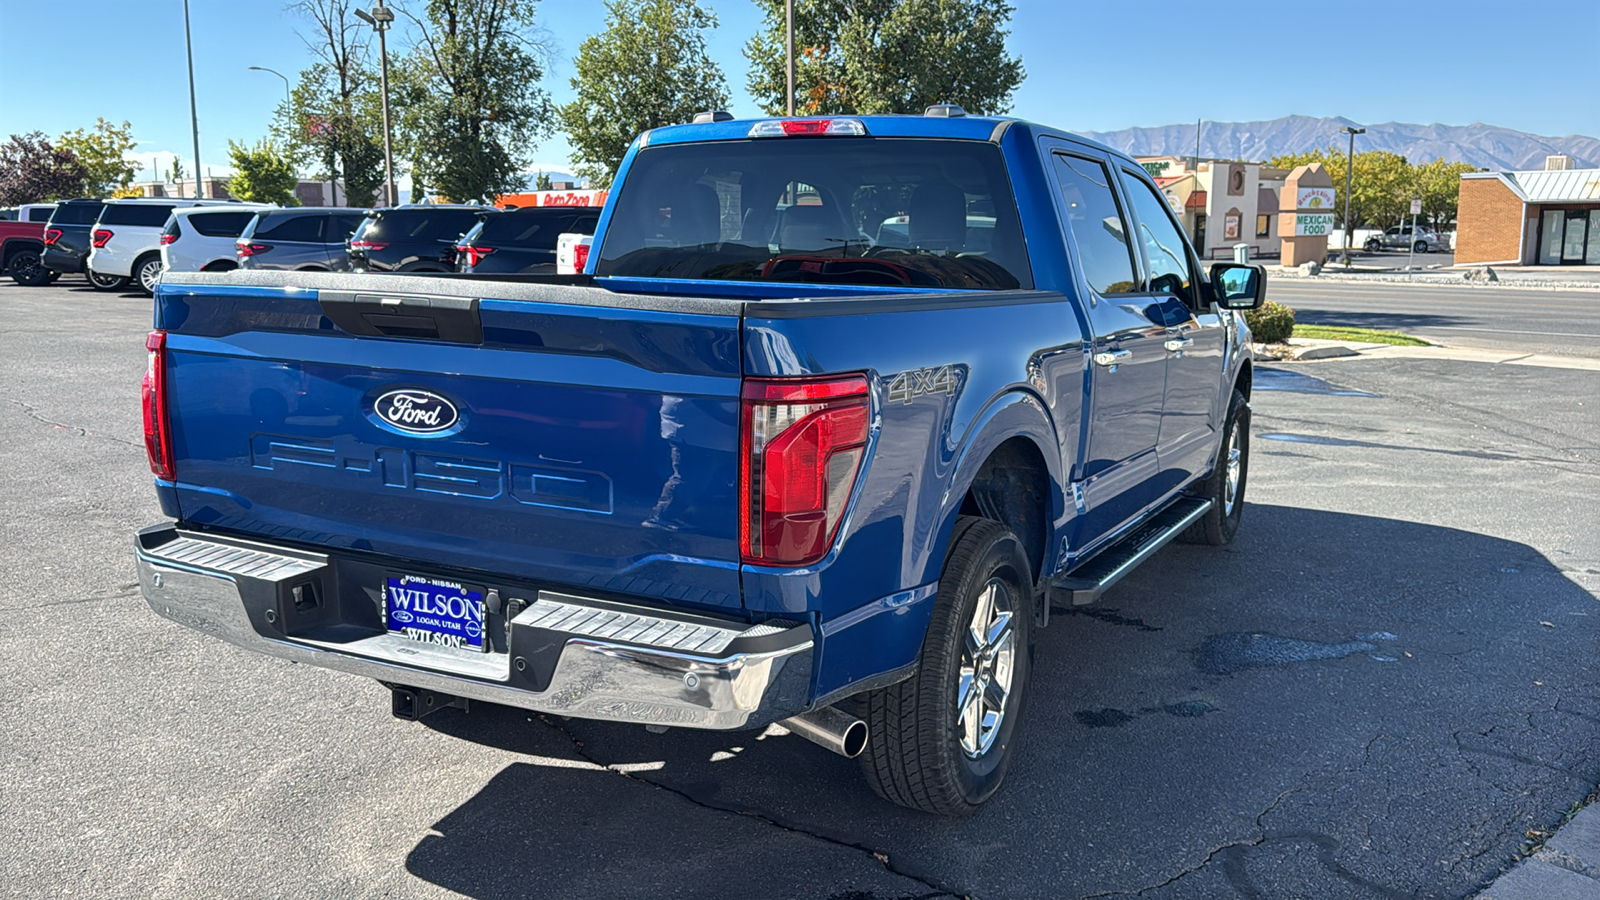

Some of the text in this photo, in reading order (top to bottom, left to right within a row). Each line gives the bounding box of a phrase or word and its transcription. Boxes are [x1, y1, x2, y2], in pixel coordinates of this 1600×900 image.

[543, 193, 590, 207] AutoZone
[1297, 215, 1333, 225] MEXICAN
[1304, 225, 1326, 234] FOOD
[388, 394, 442, 426] Ford
[249, 431, 614, 515] F-150
[405, 575, 427, 584] FORD
[432, 580, 461, 589] NISSAN
[389, 586, 482, 622] WILSON
[416, 616, 461, 630] LOGAN, UTAH
[406, 627, 463, 649] WILSON
